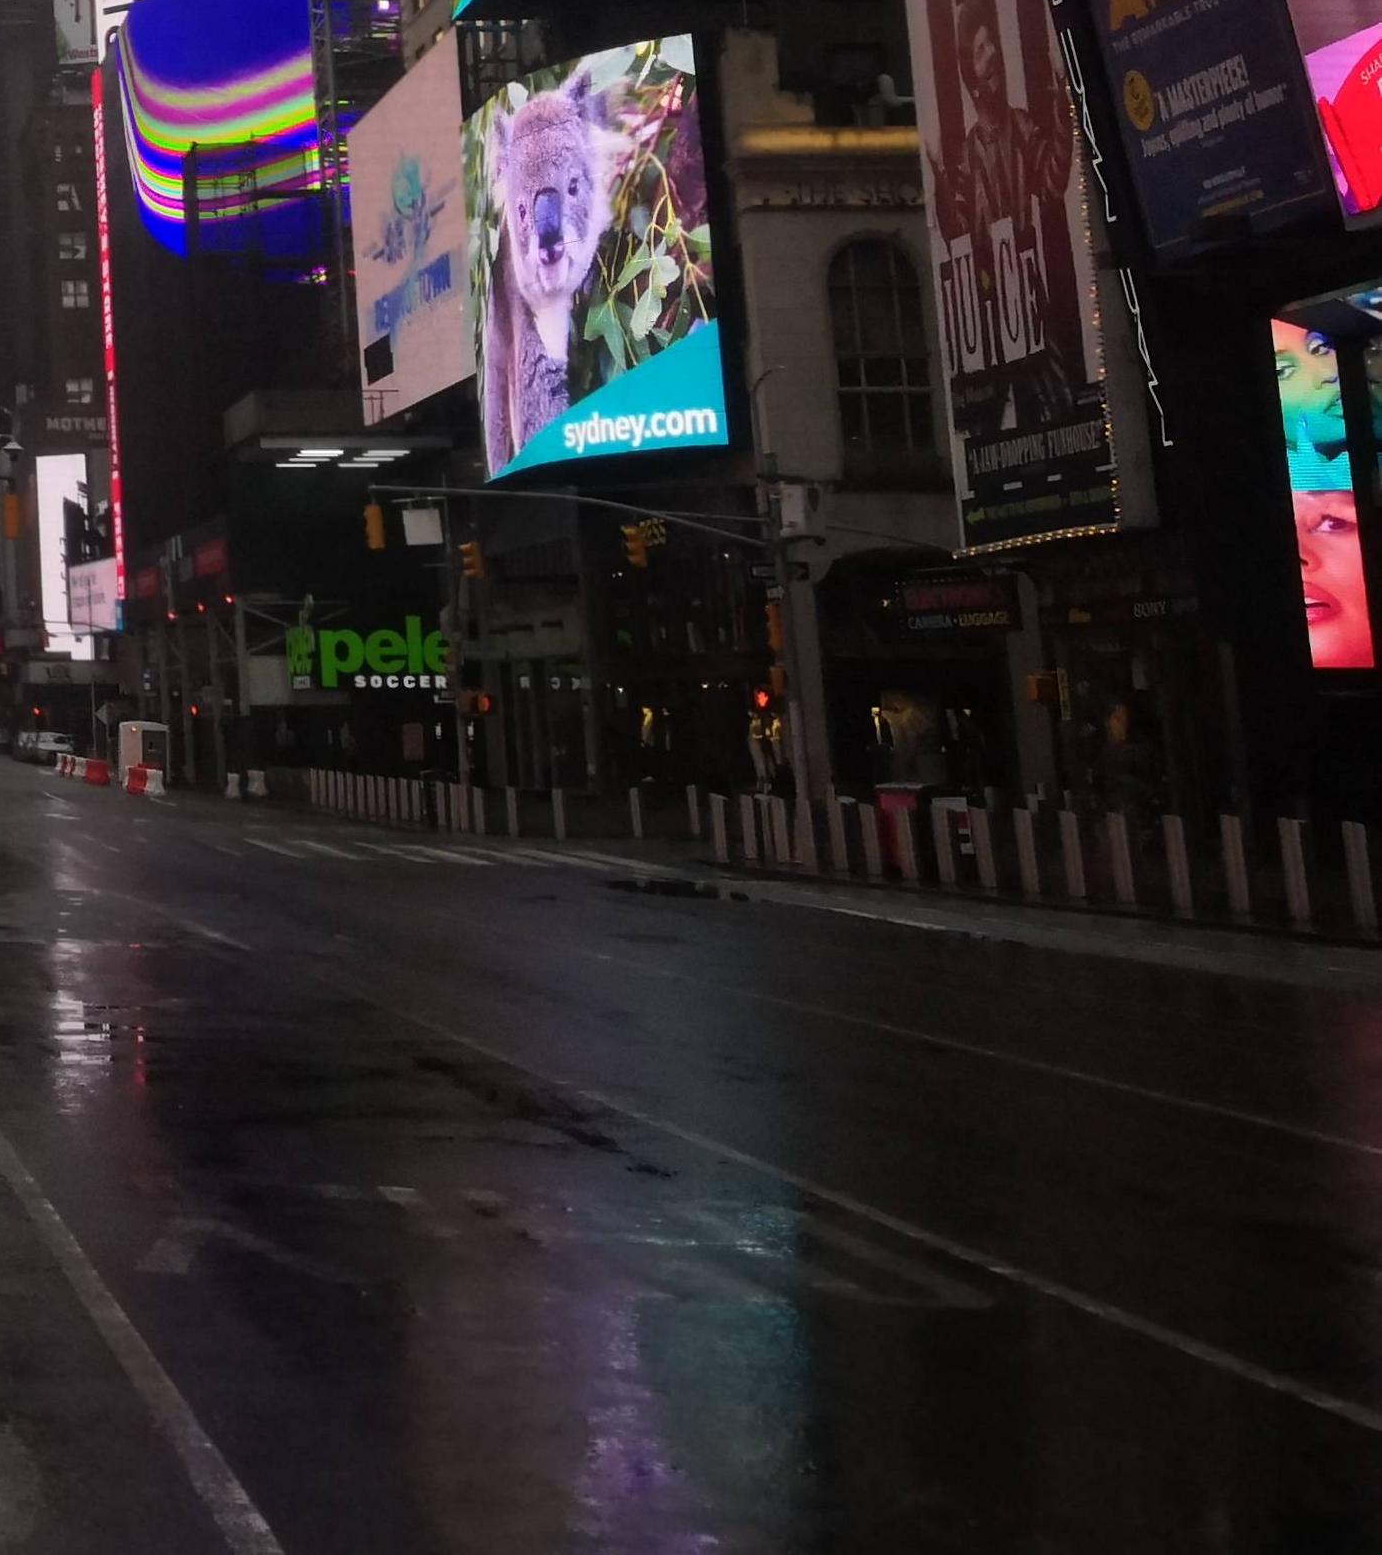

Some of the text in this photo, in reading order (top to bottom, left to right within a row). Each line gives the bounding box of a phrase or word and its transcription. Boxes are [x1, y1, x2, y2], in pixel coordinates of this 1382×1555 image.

[564, 403, 718, 455] sydney.com
[319, 614, 448, 688] pele
[354, 675, 448, 689] SOCCER
